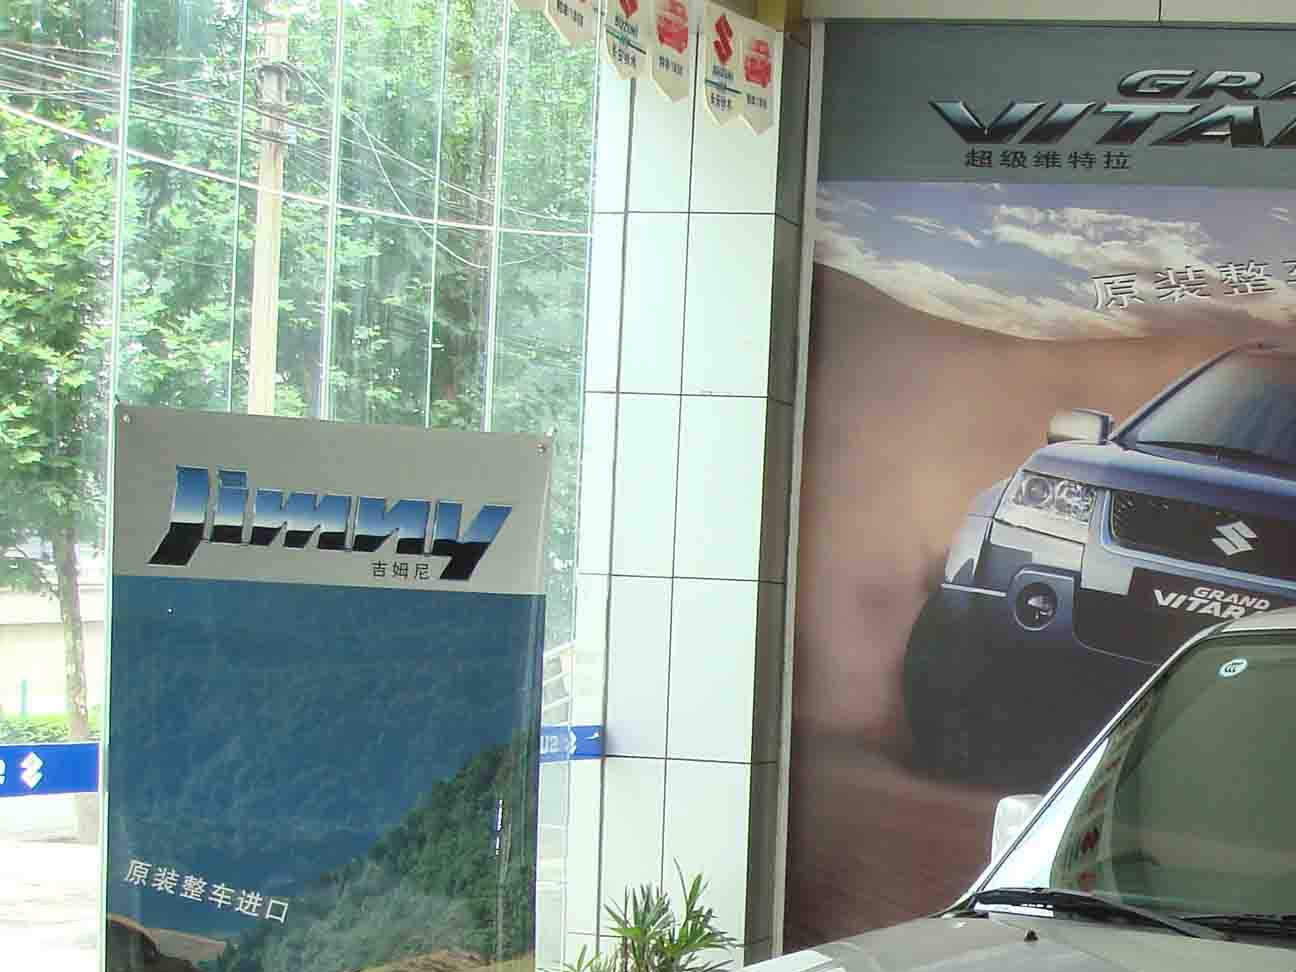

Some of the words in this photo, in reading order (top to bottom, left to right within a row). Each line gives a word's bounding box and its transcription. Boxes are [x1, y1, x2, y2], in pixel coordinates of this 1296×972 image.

[964, 148, 1133, 170] 超级维特拉
[371, 561, 431, 580] 吉姆尼
[1154, 589, 1248, 620] VITAR
[1193, 587, 1271, 610] GRAND
[123, 859, 289, 923] 原装整车进口
